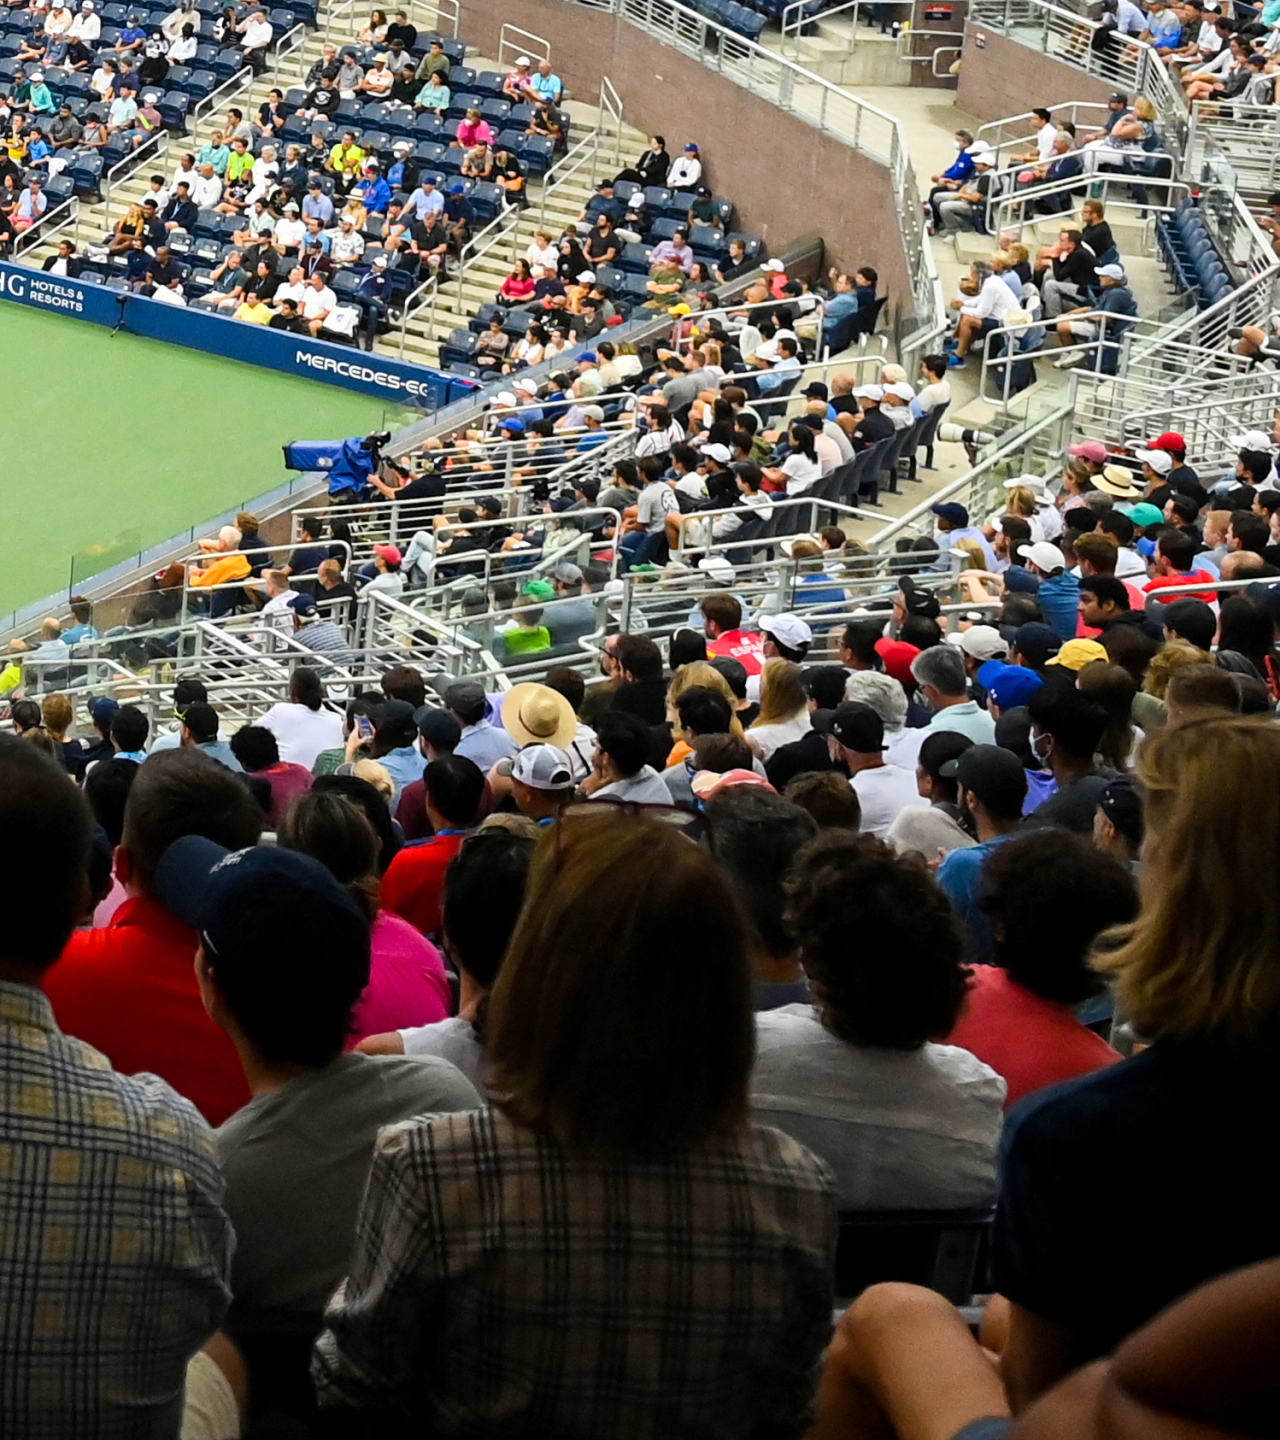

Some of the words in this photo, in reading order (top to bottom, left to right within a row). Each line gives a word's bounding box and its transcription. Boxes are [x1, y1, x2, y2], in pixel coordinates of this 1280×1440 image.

[30, 278, 75, 299] HOTELS
[76, 290, 84, 301] &
[29, 290, 84, 313] RESORTS
